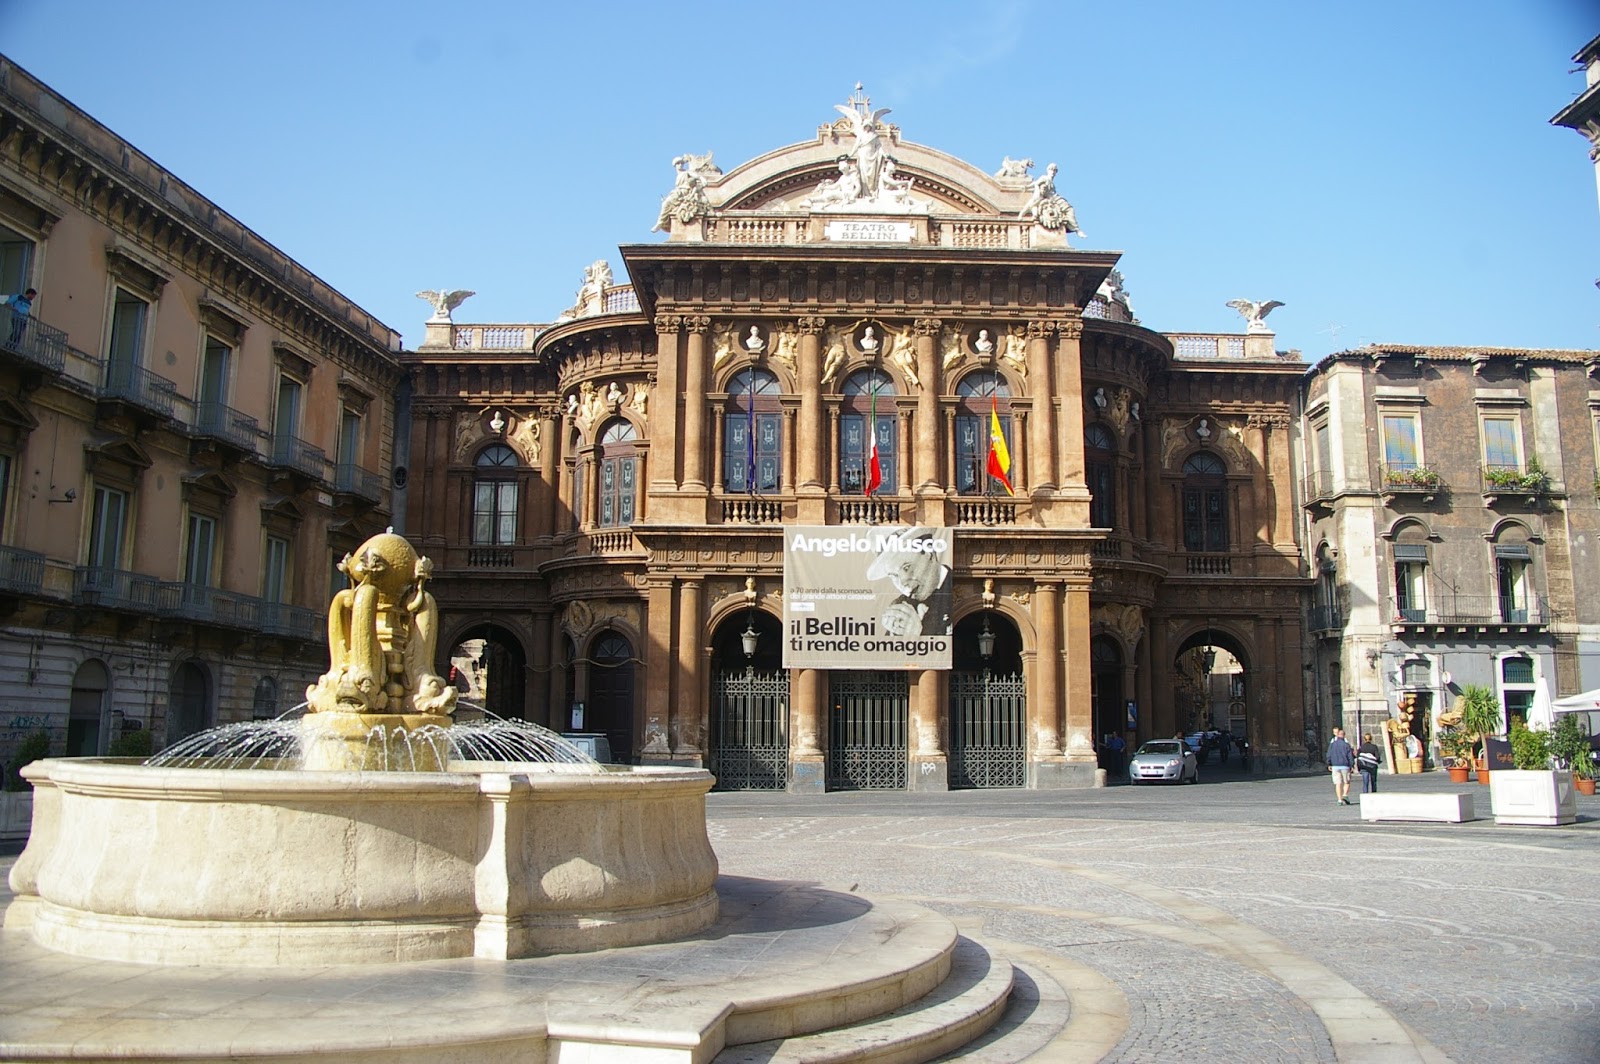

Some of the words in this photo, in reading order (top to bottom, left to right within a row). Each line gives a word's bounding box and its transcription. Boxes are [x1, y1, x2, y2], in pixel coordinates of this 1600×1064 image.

[841, 232, 898, 240] BELLINI
[844, 223, 895, 232] TEATRO
[790, 533, 871, 558] Angelo
[875, 534, 948, 553] Musco
[790, 619, 800, 636] il
[805, 616, 876, 636] Bellini
[790, 636, 803, 652] ti
[807, 636, 860, 652] rende
[863, 637, 947, 656] omaggio
